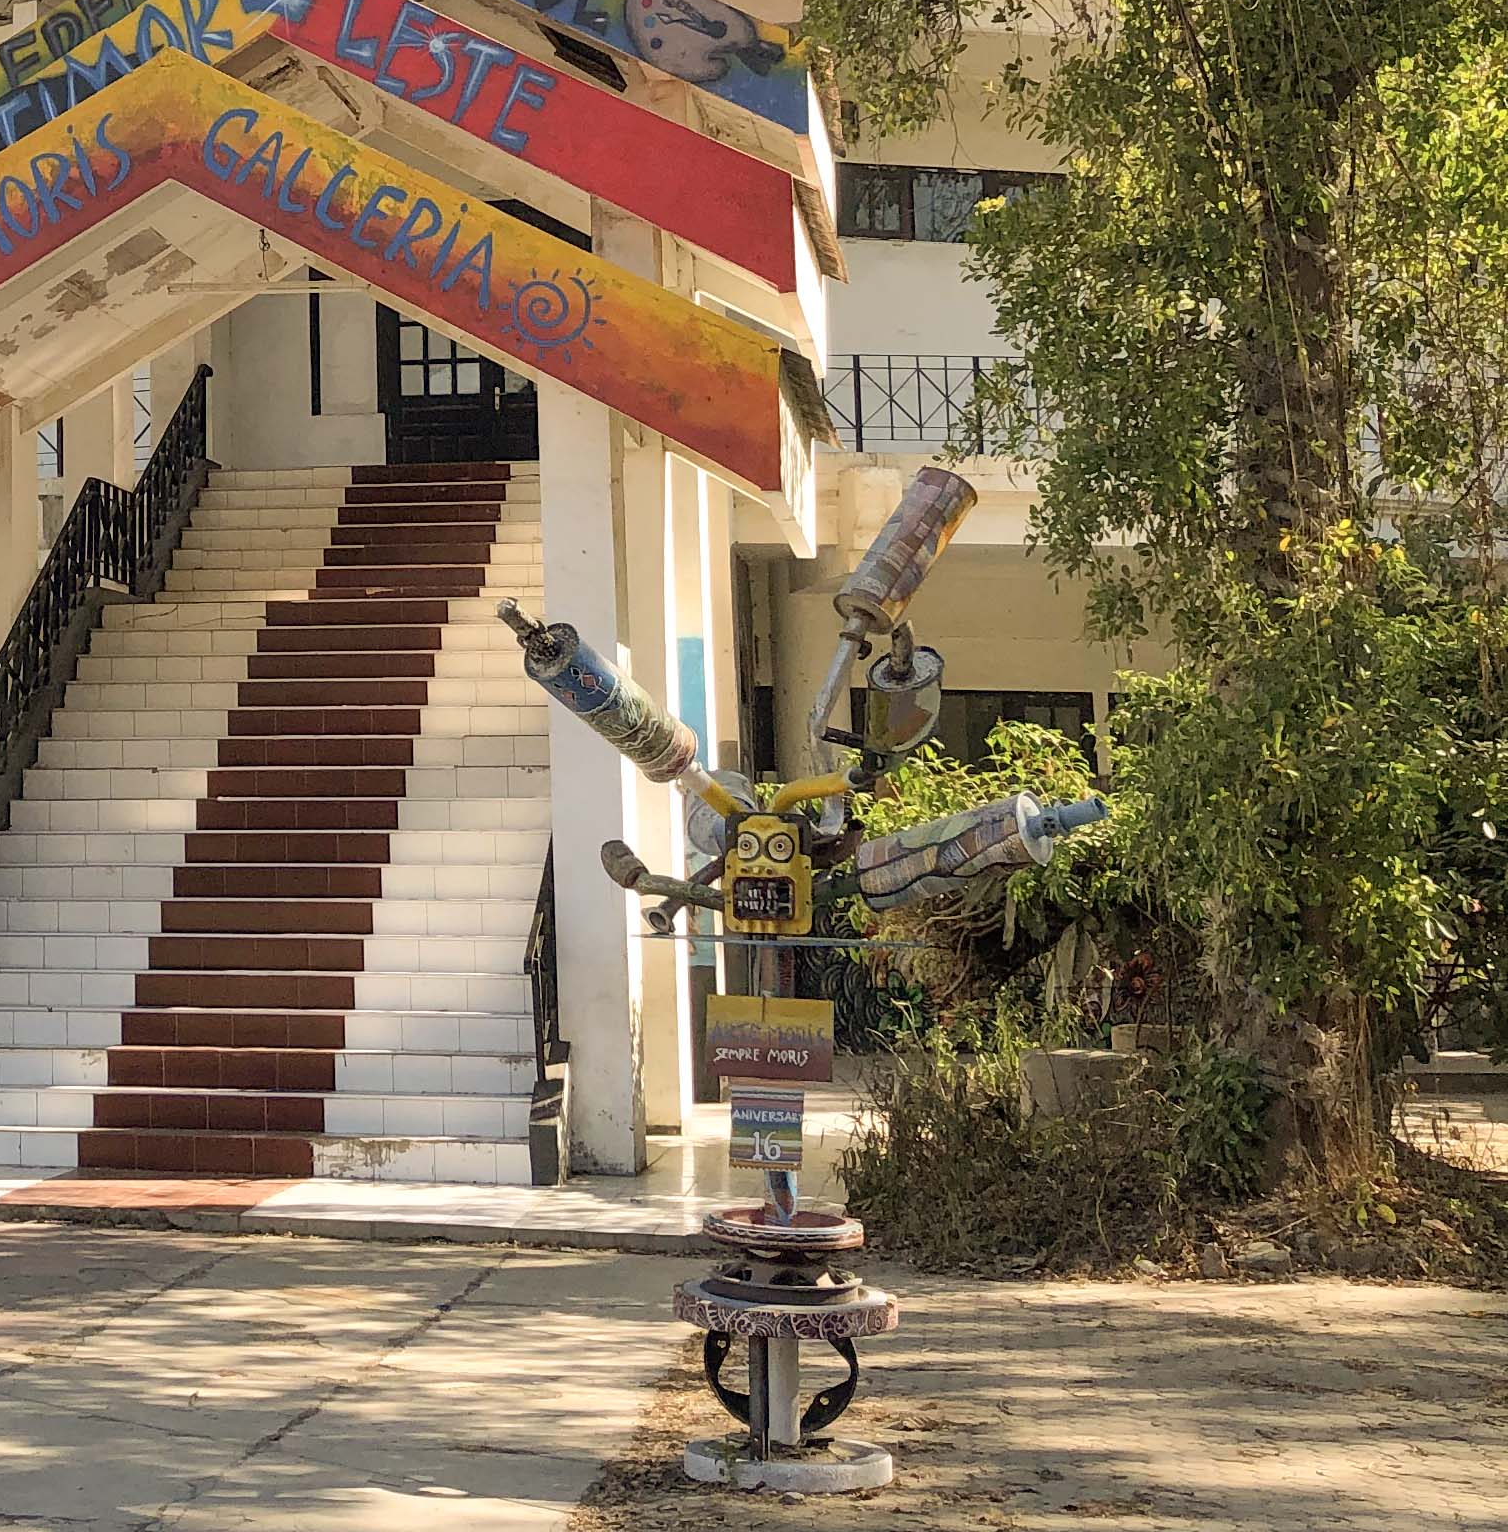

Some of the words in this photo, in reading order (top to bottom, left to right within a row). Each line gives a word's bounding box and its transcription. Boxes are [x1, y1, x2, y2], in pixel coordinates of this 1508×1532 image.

[713, 1047, 760, 1062] SEMPRE
[767, 1048, 810, 1067] MORIS
[753, 1131, 781, 1160] 16
